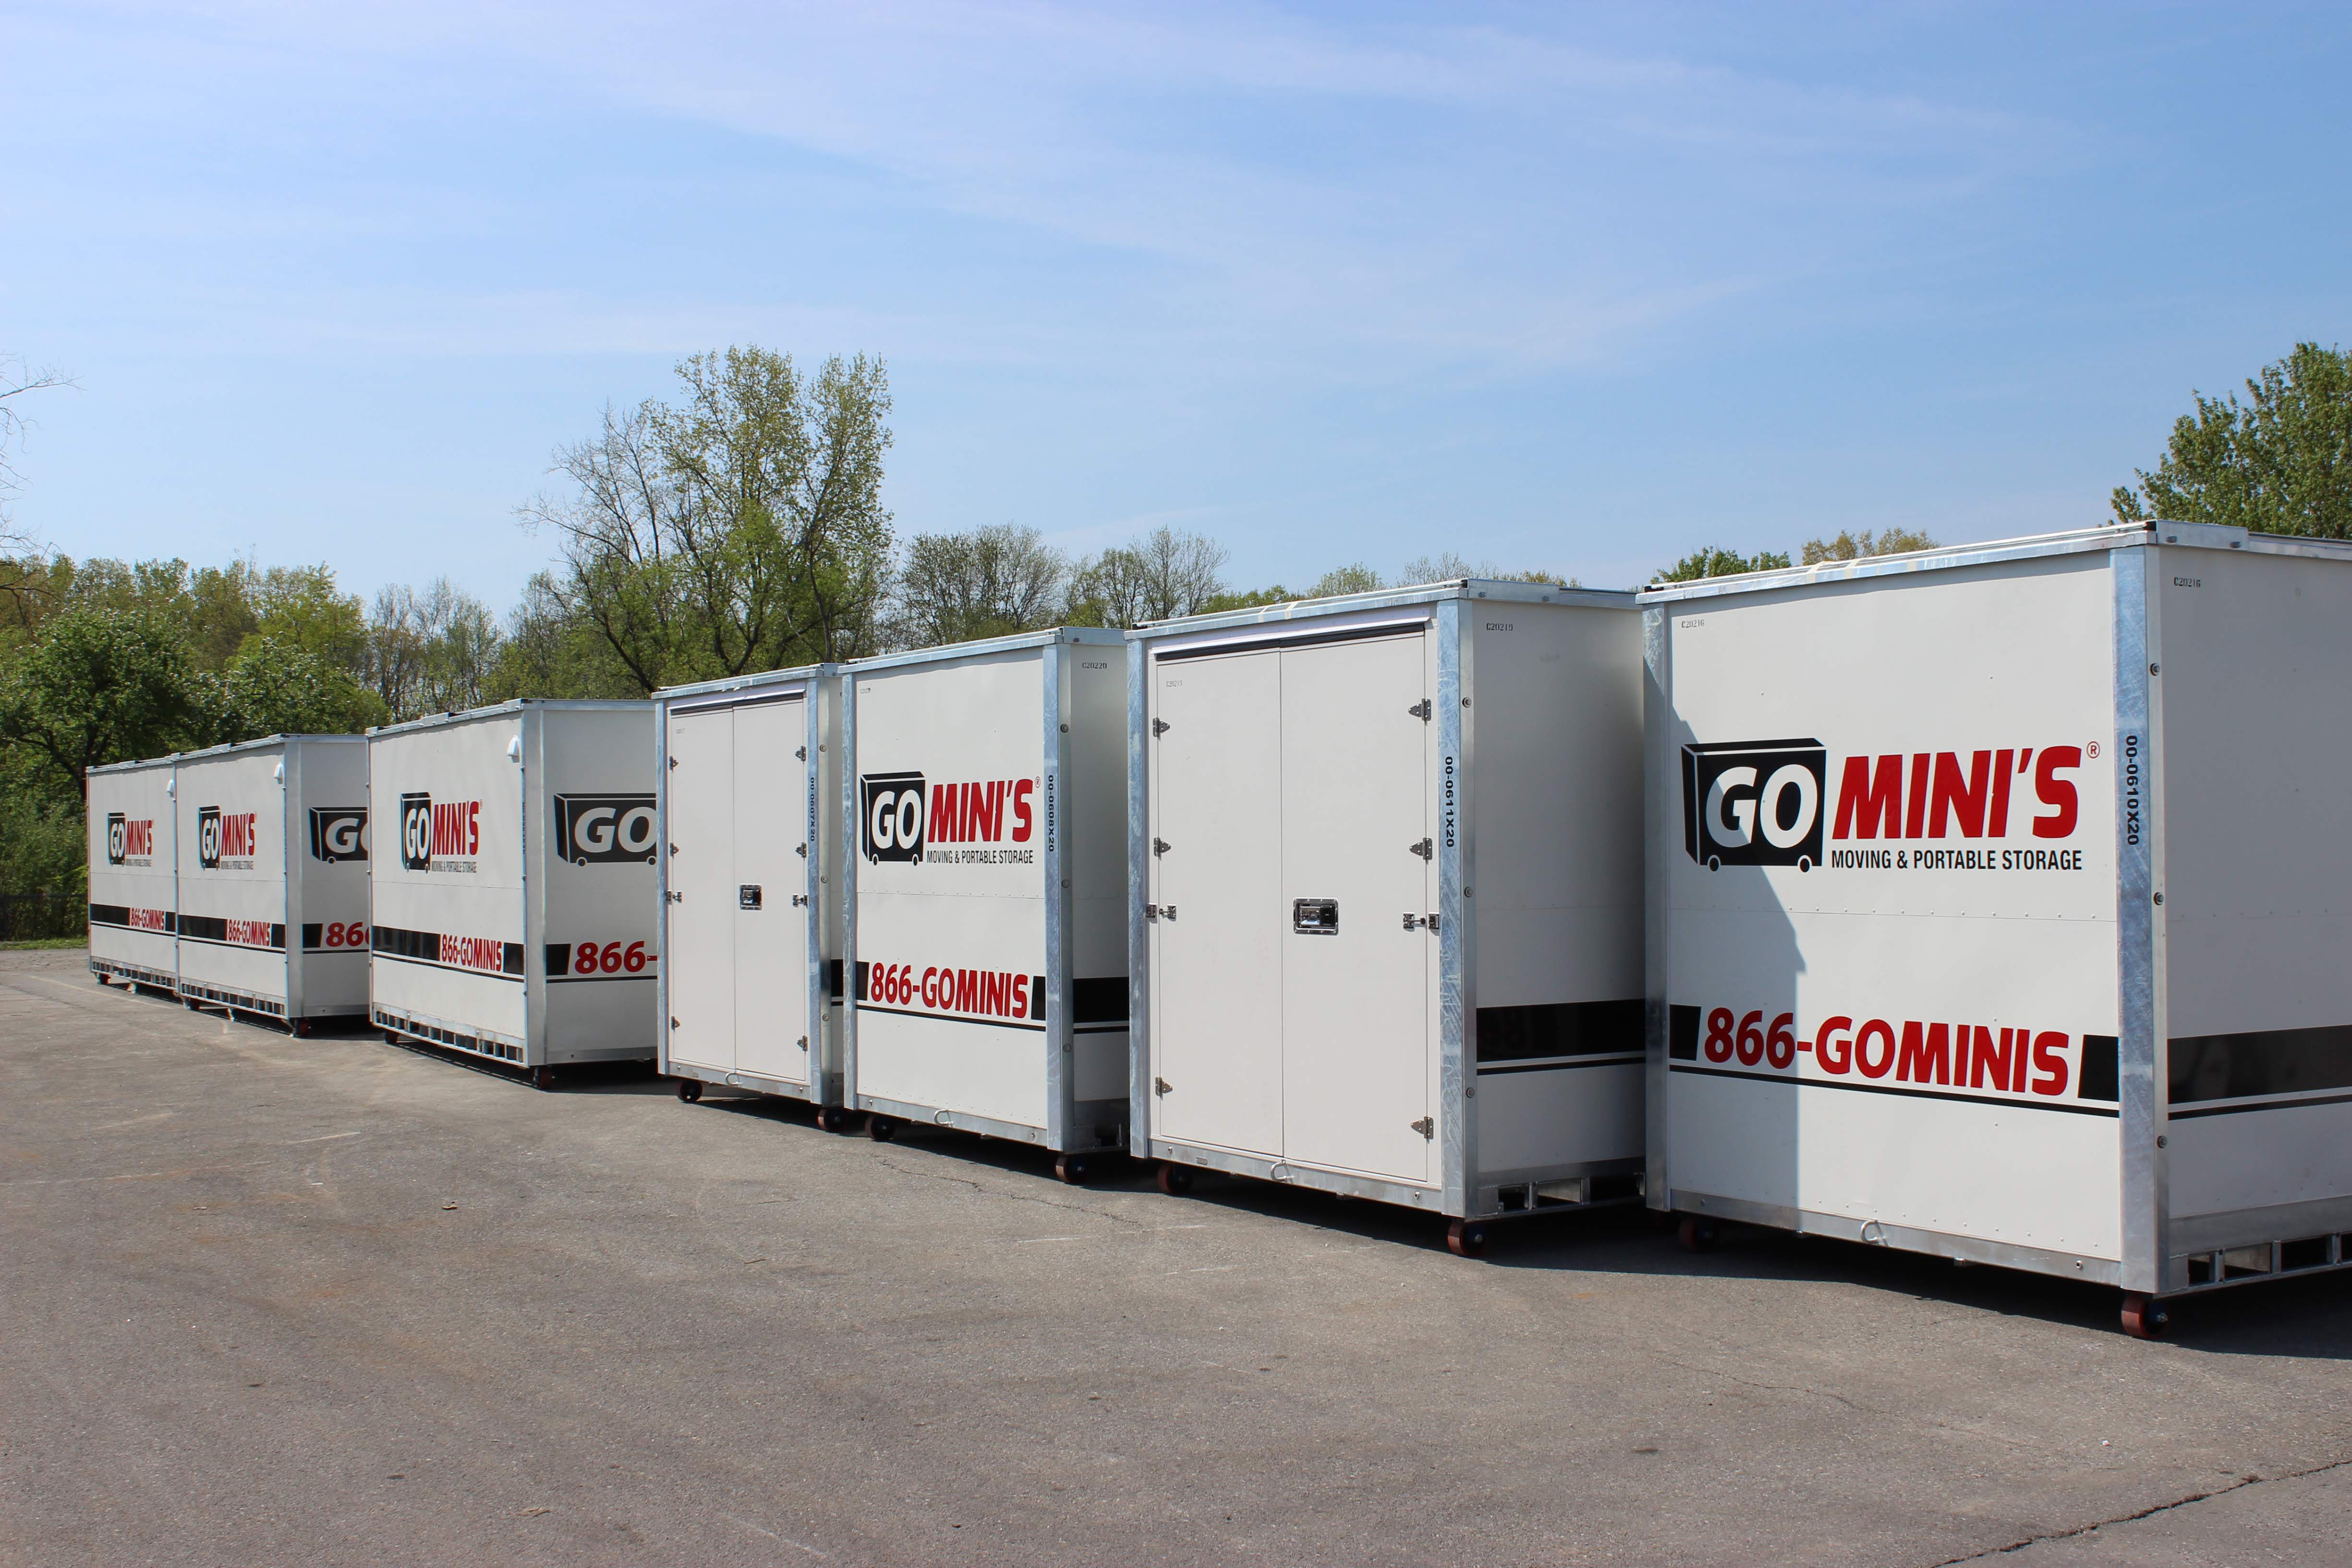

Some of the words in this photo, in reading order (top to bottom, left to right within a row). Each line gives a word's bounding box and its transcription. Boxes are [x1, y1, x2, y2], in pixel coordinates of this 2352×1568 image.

[2174, 577, 2201, 588] C20216
[1487, 623, 1513, 631] C20219
[1445, 756, 1455, 848] 00-0611X20
[1706, 764, 1817, 848] GO
[2126, 735, 2140, 845] 00-0610X20
[872, 789, 922, 850] GO
[927, 850, 953, 863] MOVING
[955, 851, 959, 863] &
[962, 851, 996, 863] PORTABLE
[999, 850, 1033, 864] STORAGE
[1831, 850, 1891, 868] MOVING
[1897, 850, 1908, 869] &
[1914, 850, 1996, 869] PORTABLE
[2002, 850, 2082, 870] STORAGE
[131, 909, 165, 930] 866-GOMINIS
[228, 919, 270, 947] 866-GOMINIS
[442, 934, 502, 972] 866-GOMINIS
[870, 962, 1028, 1019] 866-GOMINIS
[1705, 1007, 2070, 1097] 866-GOMINIS
